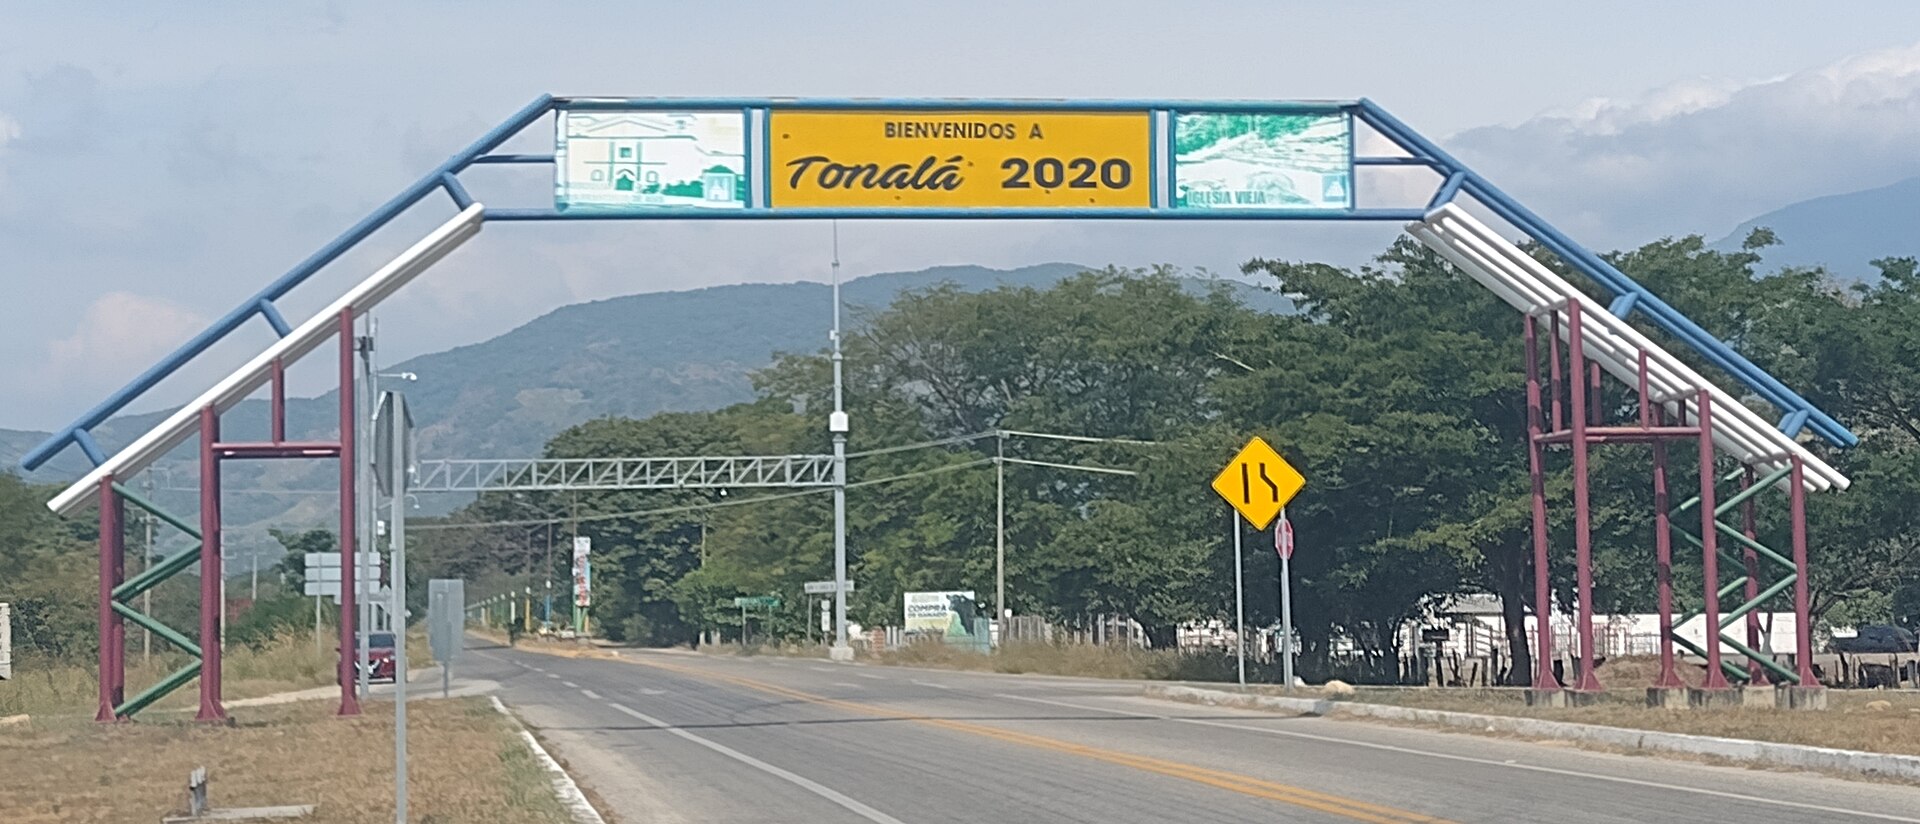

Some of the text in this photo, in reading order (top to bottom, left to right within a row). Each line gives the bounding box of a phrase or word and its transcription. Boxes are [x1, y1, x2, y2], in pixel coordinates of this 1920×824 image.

[884, 121, 1044, 140] BIENVENIDOS A
[785, 155, 1131, 191] Tonalá 2020
[1187, 191, 1266, 205] IGLESIA VIEJA
